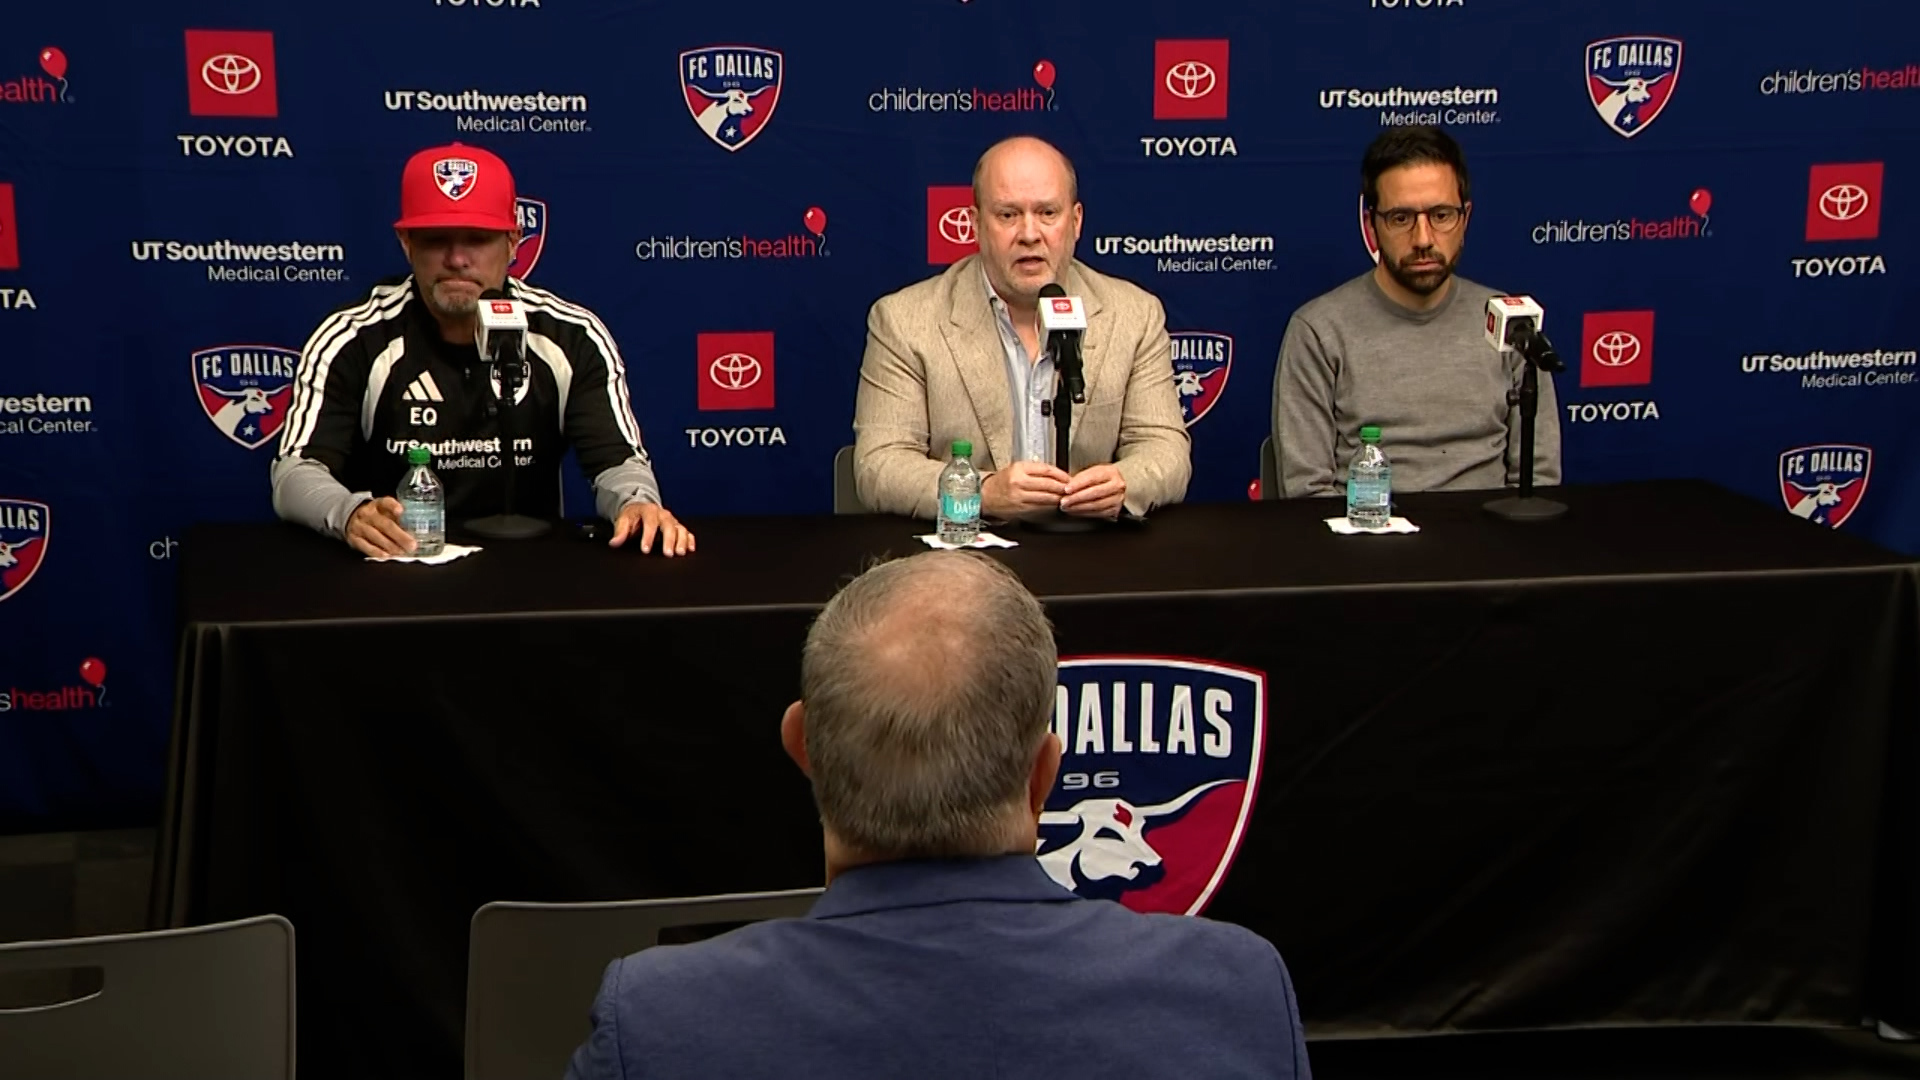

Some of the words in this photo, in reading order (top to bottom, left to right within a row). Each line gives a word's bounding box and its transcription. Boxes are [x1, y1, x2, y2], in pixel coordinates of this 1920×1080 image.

[689, 56, 707, 80] FC
[715, 53, 774, 80] DALLAS
[1593, 47, 1612, 71] FC
[1618, 43, 1673, 68] DALLAS
[456, 116, 525, 132] Medical
[528, 115, 587, 132] Center
[1381, 109, 1441, 126] Medical
[1444, 109, 1497, 125] Center
[177, 135, 293, 158] TOYOTA
[1141, 136, 1237, 157] TOYOTA
[208, 265, 280, 282] Medical
[283, 265, 343, 282] Center
[1157, 257, 1218, 273] Medical
[1220, 256, 1273, 272] Center
[1791, 255, 1886, 278] TOYOTA
[1171, 339, 1224, 362] DALLAS
[202, 354, 222, 380] FC
[230, 352, 294, 379] DALLAS
[1801, 371, 1862, 389] Medical
[1864, 370, 1916, 386] Center
[410, 407, 438, 426] EQ
[1567, 401, 1660, 423] TOYOTA
[27, 417, 92, 434] Center
[686, 427, 786, 448] TOYOTA
[1787, 455, 1804, 477] FC
[1810, 451, 1863, 474] DALLAS
[1062, 771, 1120, 790] 96
